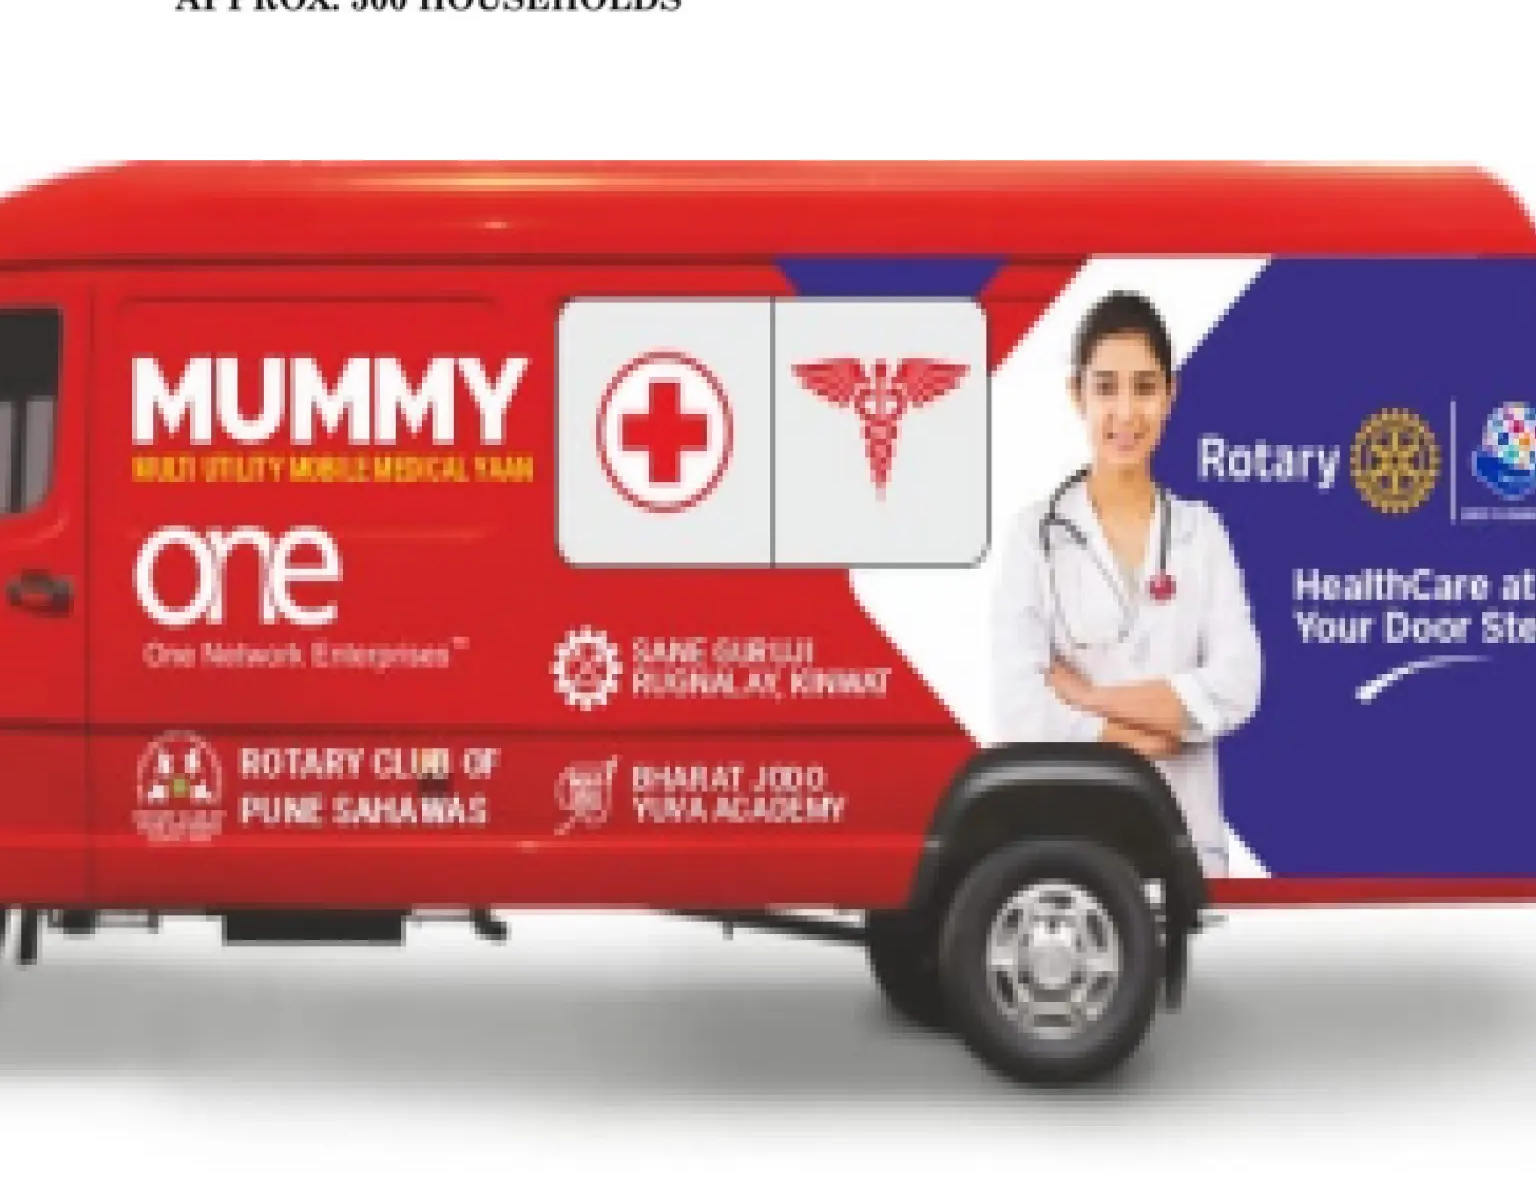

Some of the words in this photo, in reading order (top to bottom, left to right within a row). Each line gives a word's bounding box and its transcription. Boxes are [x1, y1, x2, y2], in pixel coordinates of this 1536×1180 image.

[131, 354, 532, 446] MUMMY
[131, 453, 197, 483] MULTI
[205, 453, 285, 483] UTILITY
[289, 453, 370, 483] MOBILE
[374, 453, 470, 483] MEDICAL
[1197, 432, 1340, 491] Rotary
[134, 524, 344, 628] one
[1292, 567, 1490, 601] HealthCare
[1501, 567, 1536, 601] at
[1292, 608, 1378, 644] Your
[1382, 608, 1473, 644] Door
[142, 642, 196, 668] One
[200, 642, 303, 668] Network
[632, 636, 707, 663] SANE
[240, 746, 366, 780] ROTARY
[374, 746, 450, 780] CLUB
[463, 746, 504, 780] OF
[632, 763, 745, 792] BHARAT
[751, 763, 828, 792] JODO
[240, 794, 324, 826] PUNE
[333, 794, 490, 828] SAHAWAS
[632, 794, 708, 823] YUVA
[711, 794, 848, 823] ACADEMY
